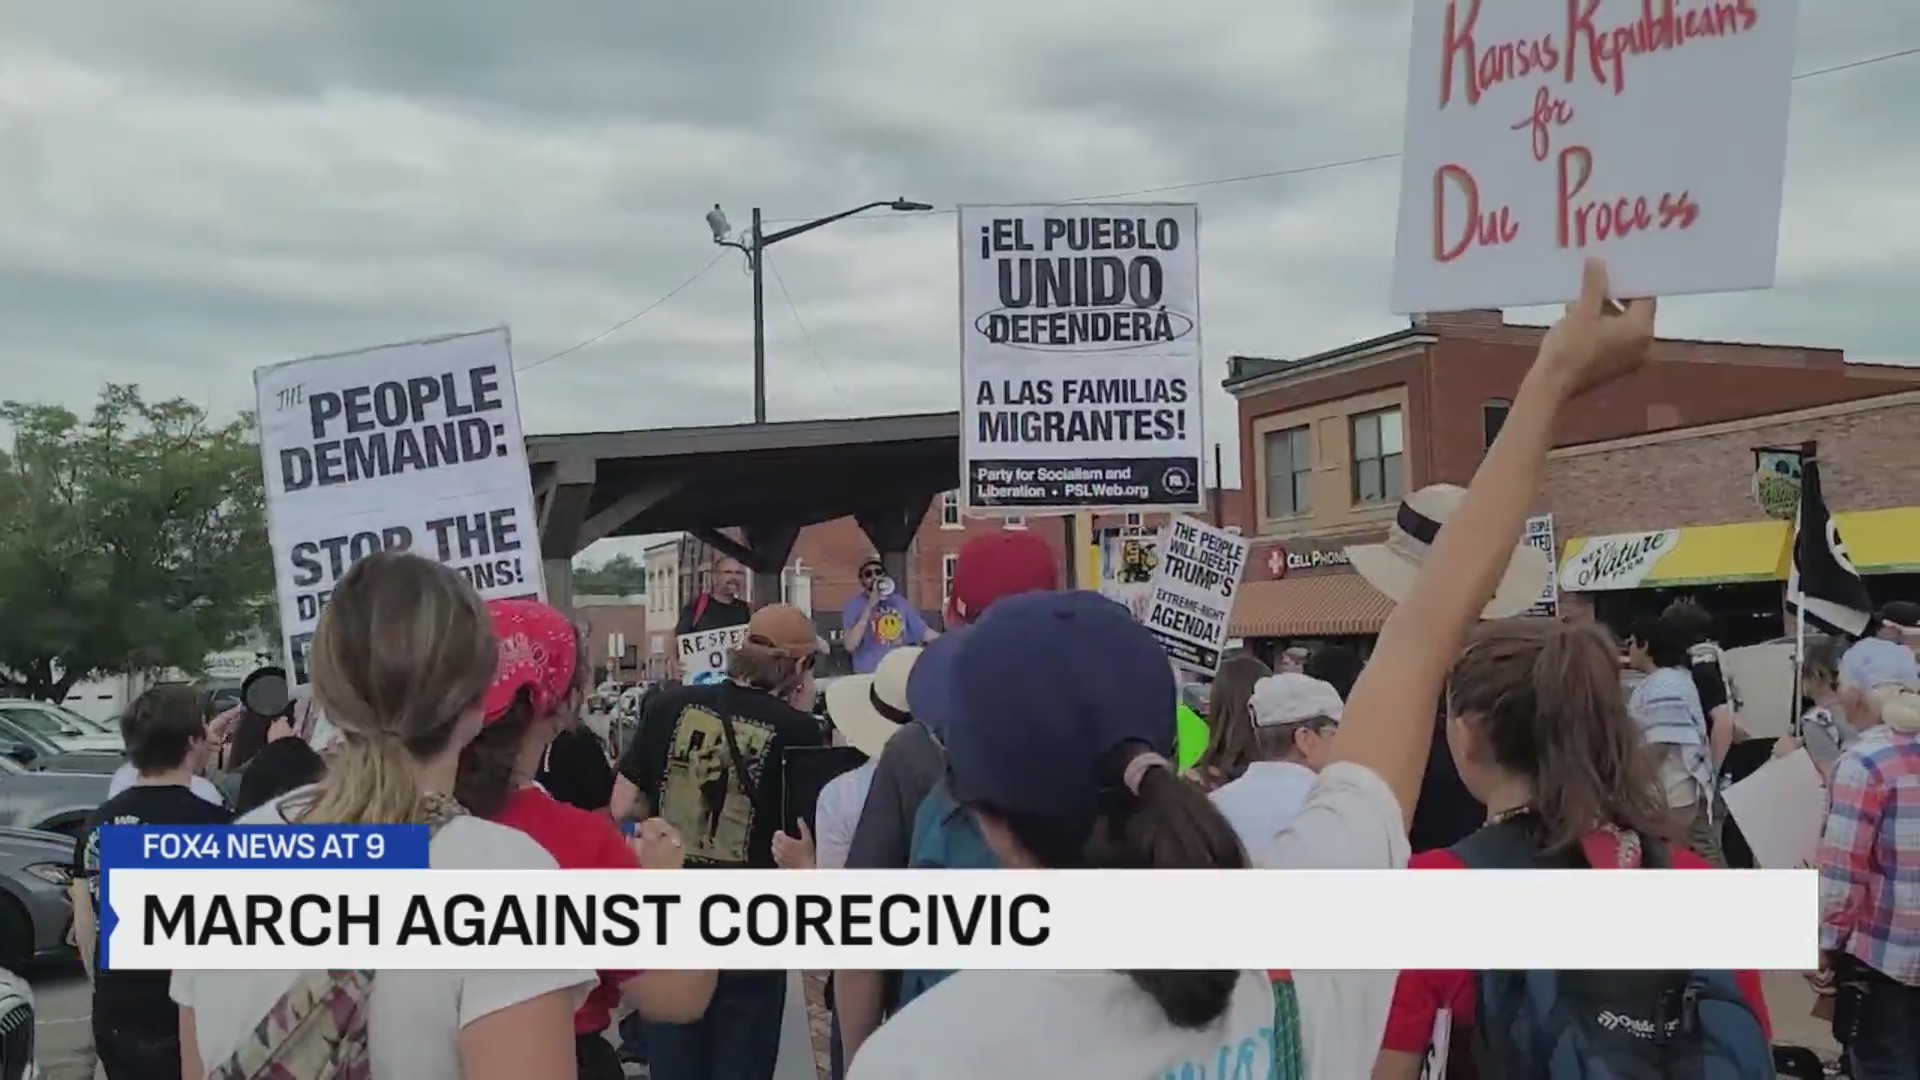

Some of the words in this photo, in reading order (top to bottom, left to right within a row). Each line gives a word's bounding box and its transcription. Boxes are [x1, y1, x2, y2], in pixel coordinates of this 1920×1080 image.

[1439, 0, 1560, 110] Kansas
[1564, 0, 1758, 96] Republicans
[1510, 86, 1574, 161] for
[1433, 163, 1519, 262] Due
[1556, 145, 1700, 250] Process
[1044, 217, 1180, 251] PUEBLO
[998, 255, 1165, 309] UNIDO
[988, 304, 1176, 345] DEFENDERÁ
[309, 365, 503, 439] PEOPLE
[976, 380, 995, 405] A
[1003, 380, 1053, 405] LAS
[1062, 378, 1188, 404] FAMILIAS
[978, 409, 1186, 443] MIGRANTES!
[280, 416, 508, 493] DEMAND:
[977, 468, 1013, 484] Party
[1015, 468, 1035, 481] for
[1037, 467, 1103, 481] Socialism
[1105, 467, 1131, 480] and
[977, 485, 1046, 498] Liberation
[1064, 483, 1149, 499] PSLWeb.org
[426, 507, 521, 562] THE
[1174, 521, 1198, 543] THE
[1200, 531, 1244, 562] PEOPLE
[1164, 553, 1235, 598] TRUMP'S
[1169, 538, 1197, 560] WILL
[1200, 550, 1239, 576] DEFEAT
[1287, 552, 1311, 569] CELL
[1578, 533, 1665, 586] Nature
[1150, 602, 1222, 645] AGENDA!
